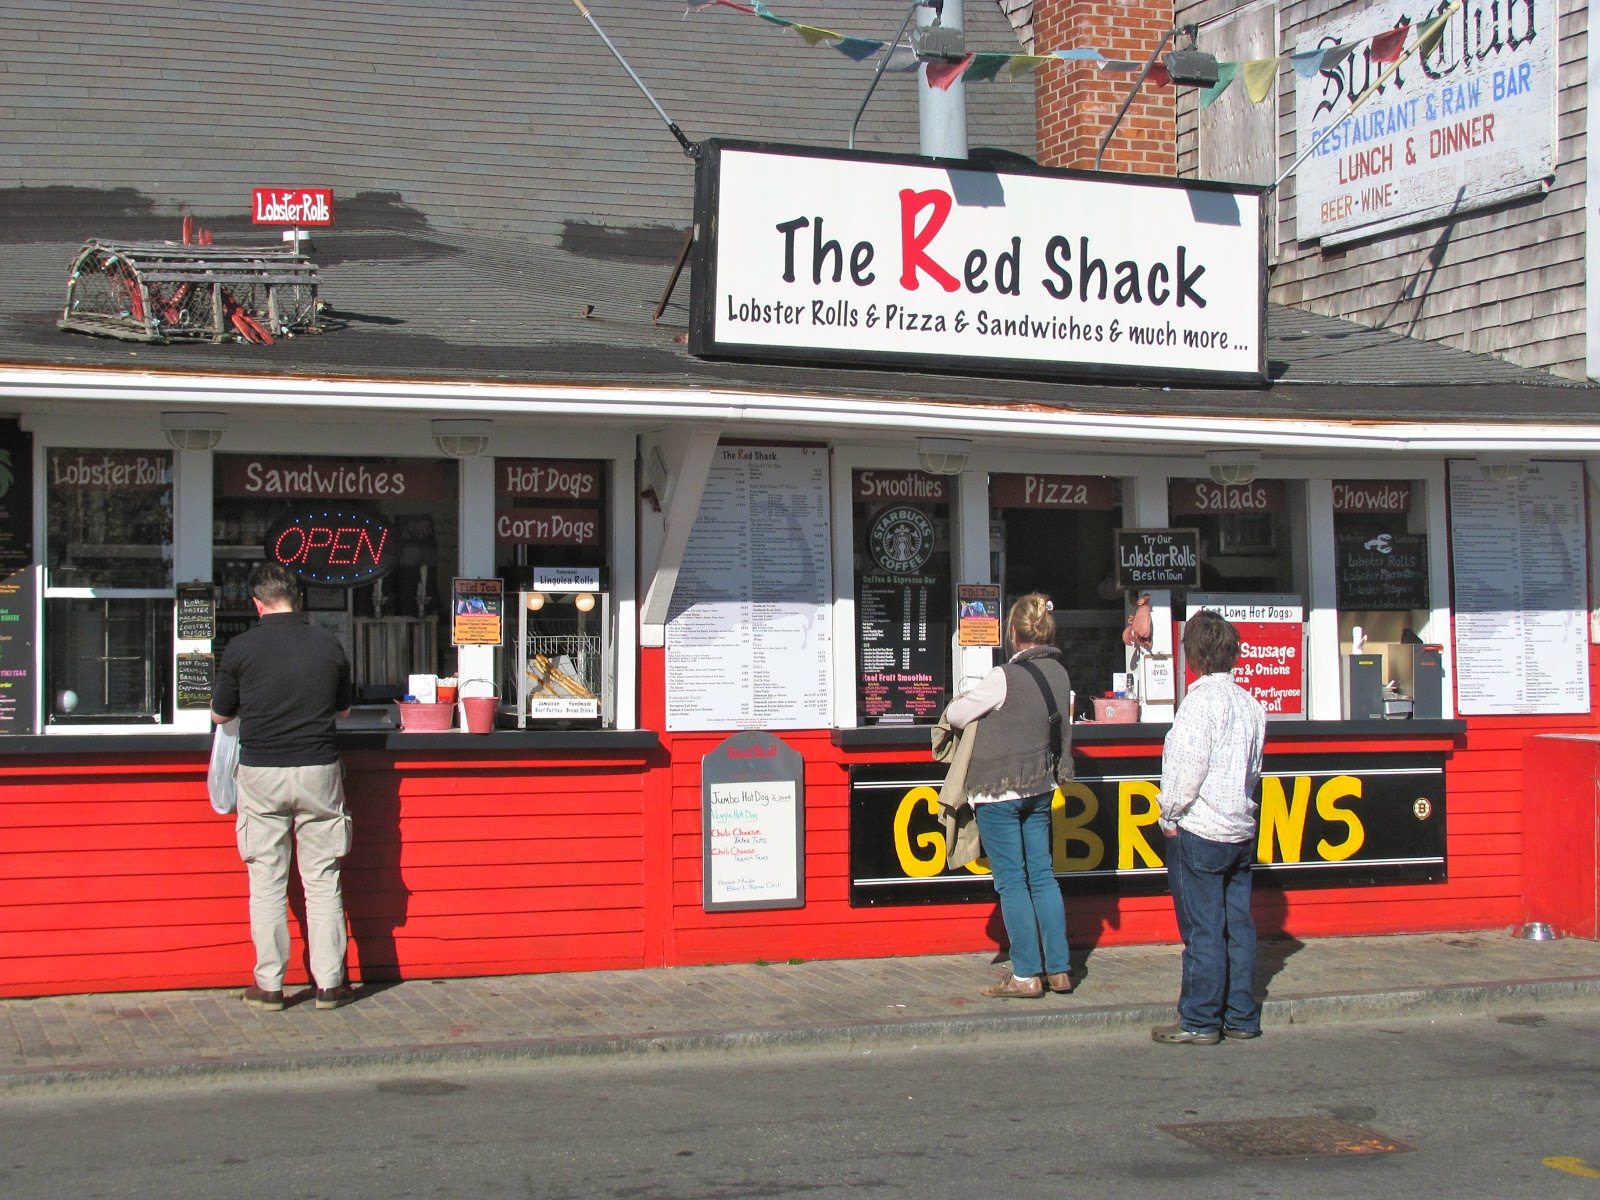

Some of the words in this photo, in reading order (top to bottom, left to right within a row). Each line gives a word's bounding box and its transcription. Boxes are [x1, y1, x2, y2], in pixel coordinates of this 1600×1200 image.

[1312, 97, 1418, 158] RESTAURANT
[1425, 93, 1437, 121] &
[1442, 78, 1480, 117] RAW
[1493, 62, 1531, 103] BAR
[1339, 143, 1393, 186] LUNCH
[1405, 137, 1417, 166] &
[1430, 113, 1495, 159] DINNER
[256, 192, 303, 221] Lobster
[302, 194, 330, 222] Rolls
[1321, 194, 1353, 225] BEER
[1361, 183, 1393, 213] WINE
[776, 216, 875, 286] The
[899, 188, 1021, 296] Red
[1042, 235, 1207, 309] Shack
[728, 294, 805, 325] Lobster
[811, 300, 858, 327] Rolls
[865, 304, 880, 328] &
[885, 304, 946, 332] Pizza
[954, 310, 969, 333] &
[976, 310, 1103, 342] Sandwiches
[1109, 318, 1123, 343] &
[1129, 321, 1177, 346] much
[1183, 329, 1229, 350] more
[723, 451, 736, 460] The
[737, 448, 752, 460] Red
[754, 451, 778, 461] Shack
[52, 457, 136, 485] Lobster
[245, 462, 406, 495] Sandwiches
[507, 467, 545, 493] Hot
[545, 467, 594, 499] Dogs
[861, 471, 943, 497] Smoothies
[1025, 476, 1088, 505] Pizza
[1194, 483, 1268, 510] Salads
[1332, 485, 1409, 509] Chowder
[497, 515, 549, 539] Corn
[551, 515, 594, 543] Dogs
[873, 510, 932, 540] STARBUCKS
[275, 526, 389, 565] OPEN
[1141, 535, 1157, 546] Try
[1157, 534, 1173, 544] Our
[880, 553, 924, 571] COFFEE
[1120, 545, 1169, 567] Lobster
[1169, 545, 1196, 567] Rolls
[1348, 554, 1385, 568] Lobster
[540, 576, 572, 586] Linguica
[574, 576, 594, 585] Rolls
[863, 575, 885, 583] Coffee
[893, 575, 923, 584] Espresso
[1157, 570, 1166, 580] in
[480, 582, 497, 592] Tea
[961, 588, 979, 597] Tiki
[980, 588, 996, 597] Tea
[1201, 606, 1221, 614] Ft
[1224, 606, 1246, 620] Long
[1249, 607, 1265, 618] Hot
[1268, 607, 1289, 620] Dogs
[1240, 642, 1296, 664] Sausage
[879, 673, 896, 682] Fruit
[897, 673, 933, 682] Smoothies
[1245, 664, 1254, 676] &
[1255, 663, 1291, 675] Onions
[1254, 686, 1301, 701] Portuguese
[1260, 700, 1282, 711] Roll
[727, 745, 753, 759] Red
[753, 744, 778, 759] Bull
[711, 791, 740, 805] Jumbo
[742, 790, 754, 802] Hot
[754, 790, 770, 807] Dog
[711, 809, 732, 824] Veggie
[733, 809, 743, 819] Hot
[745, 809, 758, 822] Dog
[1052, 776, 1365, 872] BRNS
[711, 828, 731, 837] Chili
[732, 827, 763, 837] Cheese
[711, 847, 730, 856] Chili
[730, 846, 757, 856] Cheese
